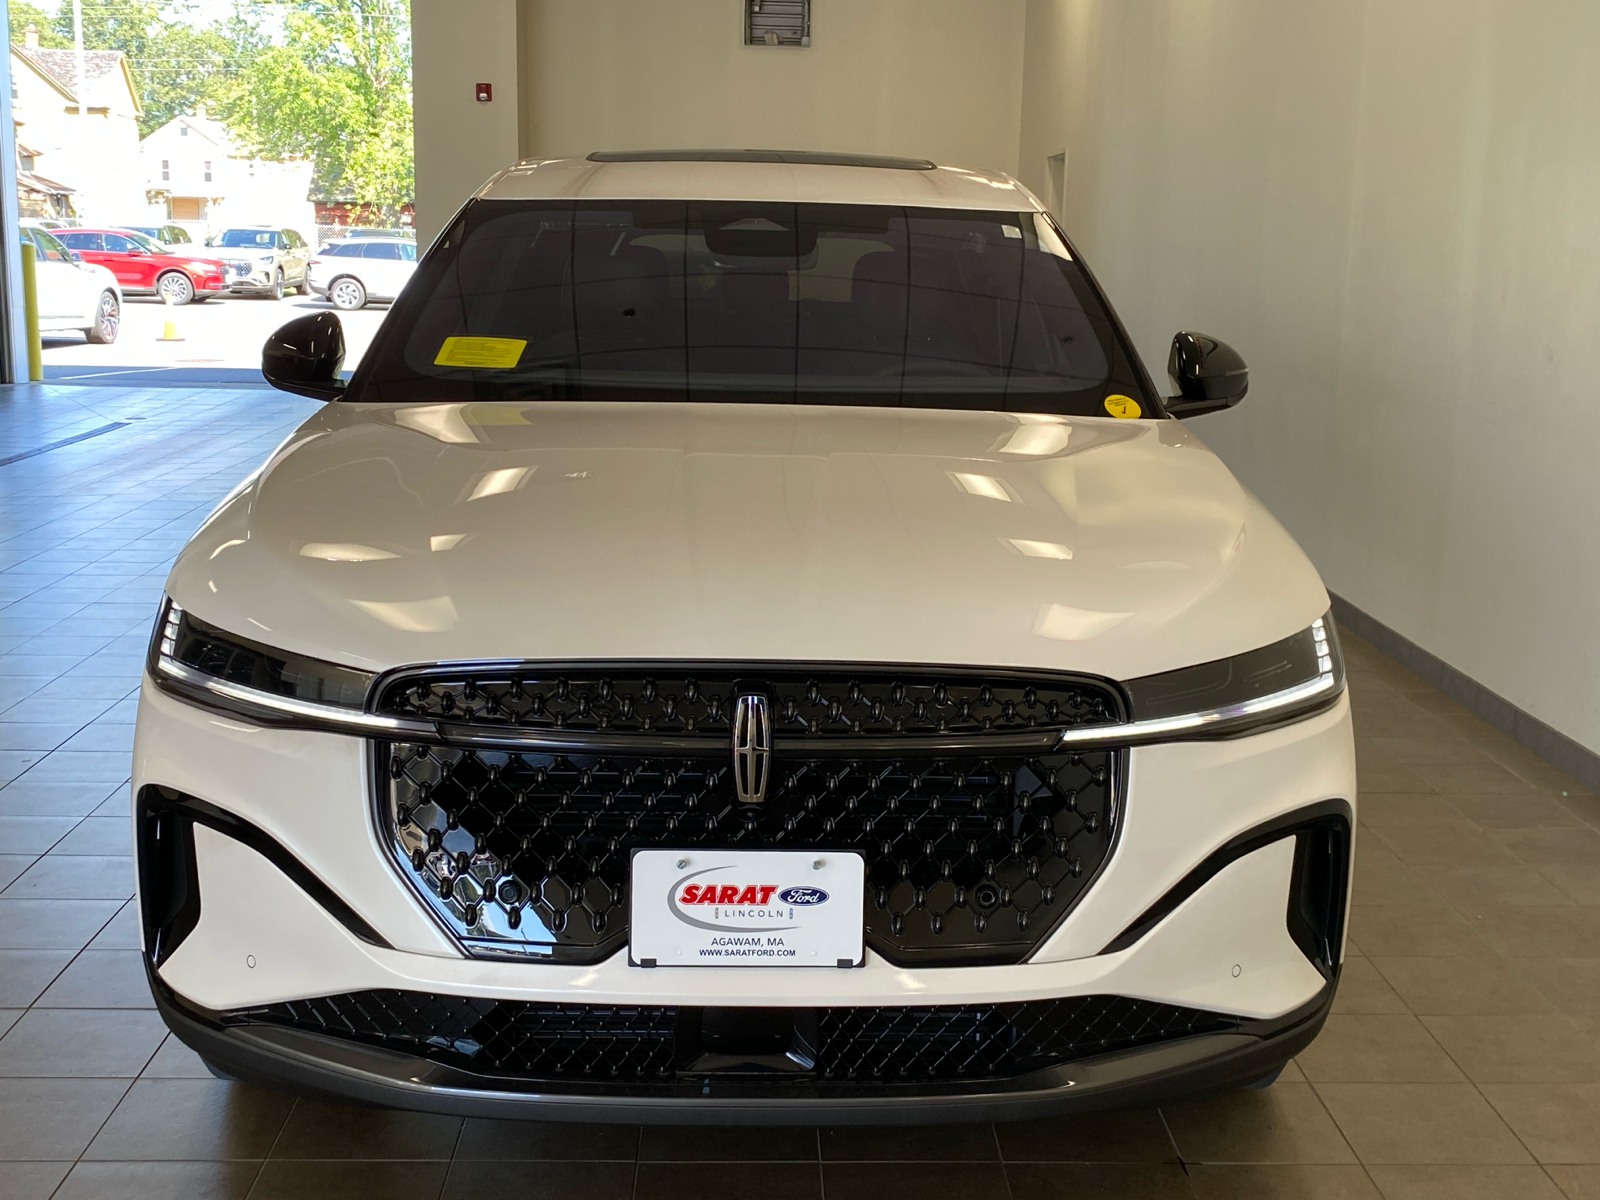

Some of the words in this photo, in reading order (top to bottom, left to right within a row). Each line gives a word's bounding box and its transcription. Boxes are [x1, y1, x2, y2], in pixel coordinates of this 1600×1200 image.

[679, 884, 779, 905] SARAT
[786, 888, 821, 904] Ford
[724, 909, 784, 918] LINCOLN
[710, 937, 764, 948] AGAWAM,
[767, 937, 785, 947] MA
[699, 949, 796, 957] WWW.SARATFORD.COM
